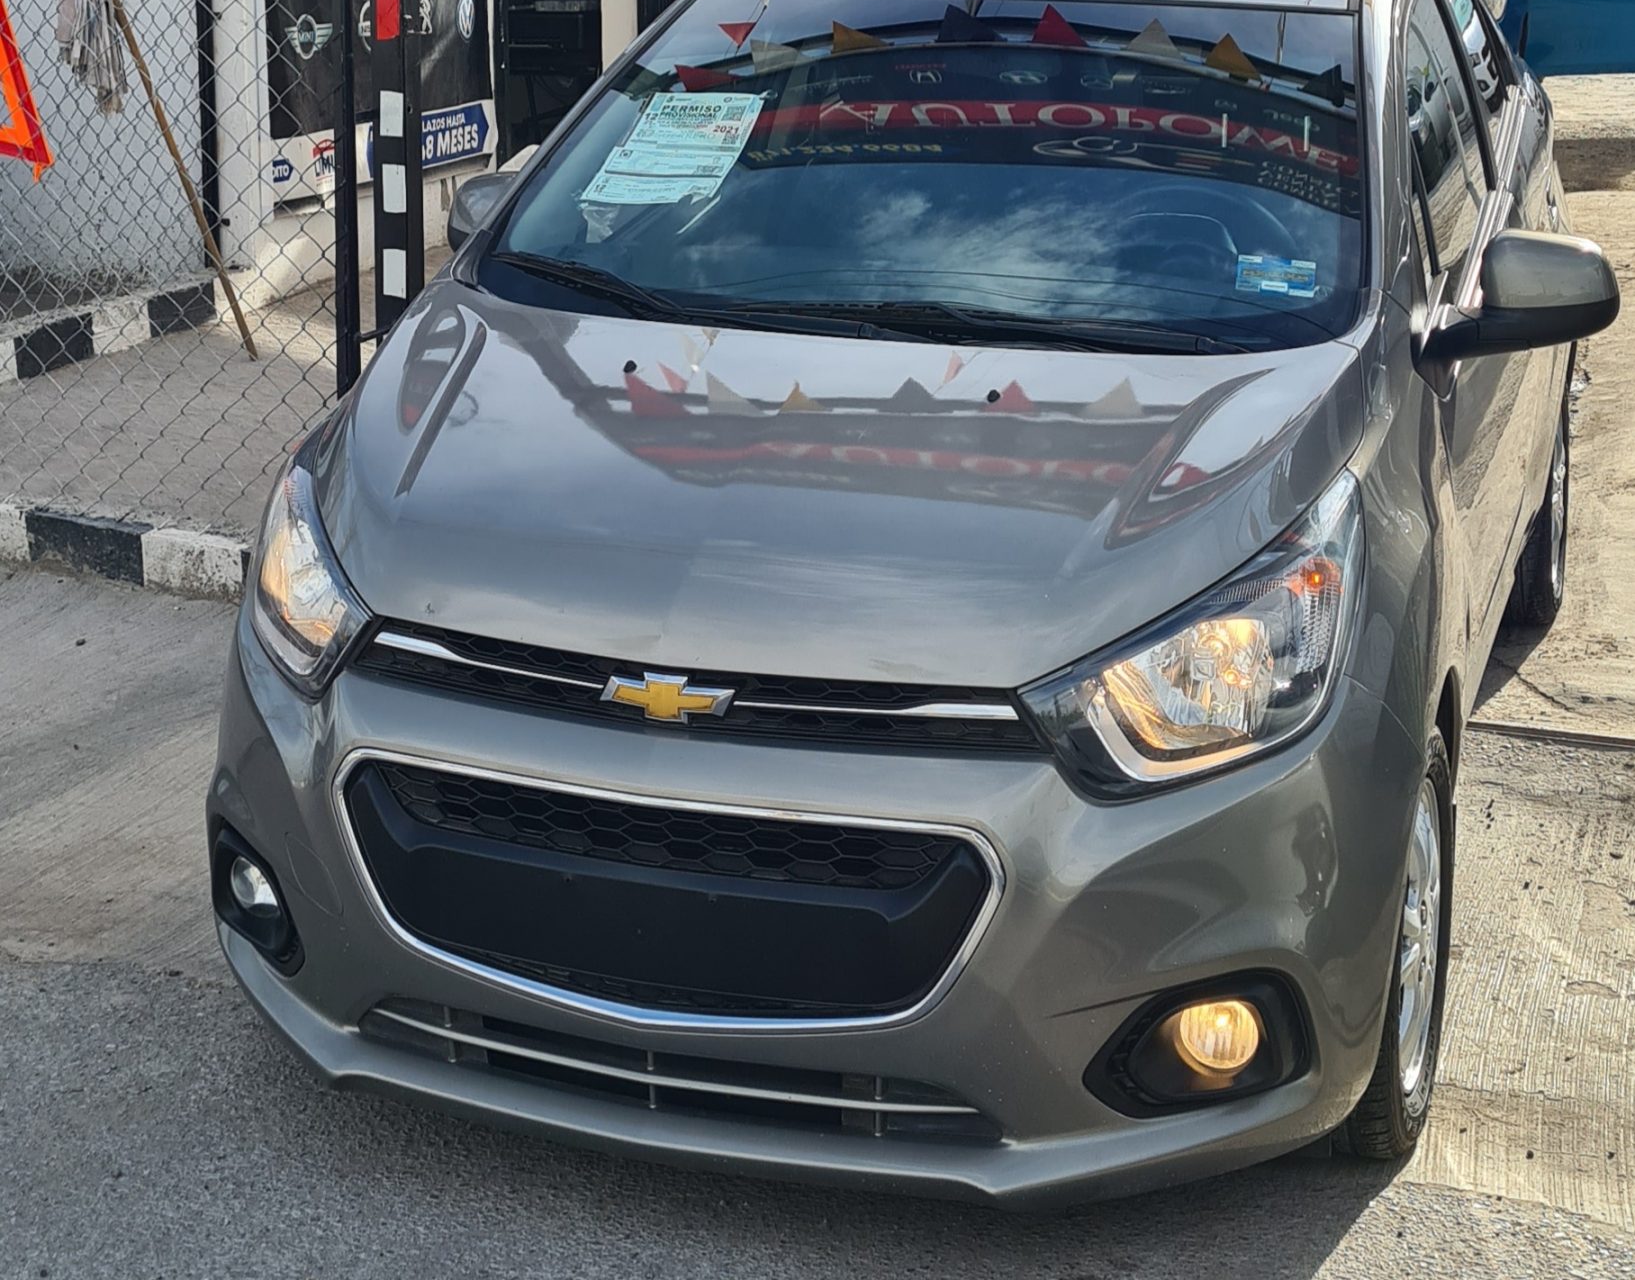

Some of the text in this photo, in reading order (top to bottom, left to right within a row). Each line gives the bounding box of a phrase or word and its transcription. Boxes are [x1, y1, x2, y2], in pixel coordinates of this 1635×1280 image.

[662, 104, 722, 113] PERMISO
[713, 124, 740, 135] 2021
[437, 123, 479, 158] MESES
